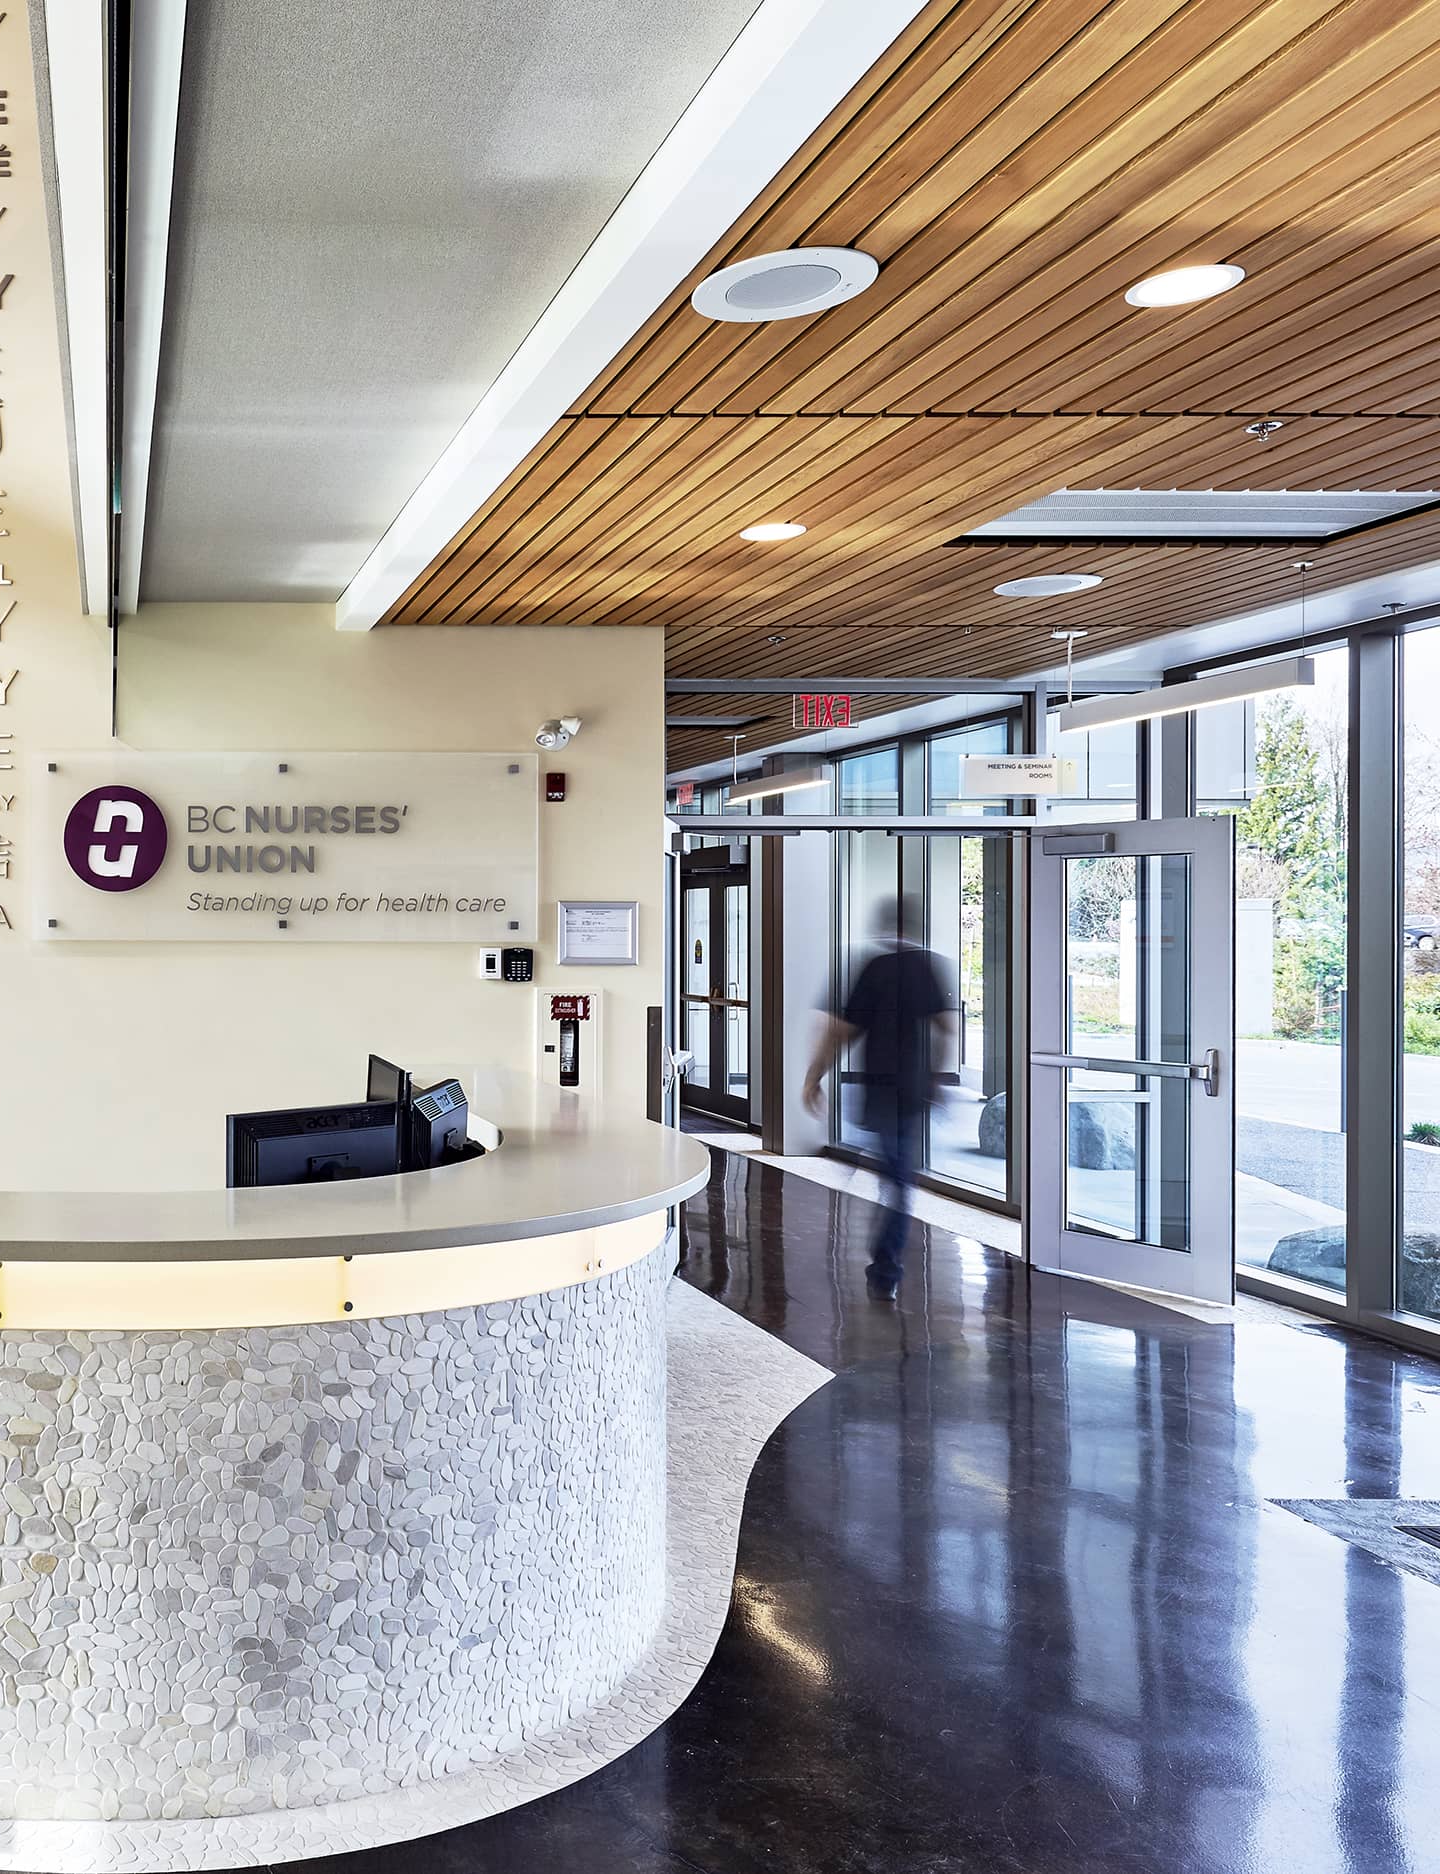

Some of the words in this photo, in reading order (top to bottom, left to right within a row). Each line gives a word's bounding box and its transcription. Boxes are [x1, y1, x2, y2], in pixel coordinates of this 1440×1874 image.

[186, 805, 237, 834] BC
[244, 805, 409, 835] NURSES'
[186, 845, 317, 874] UNION
[186, 892, 293, 915] Standing
[298, 899, 329, 915] up
[334, 892, 371, 912] for
[375, 892, 449, 912] health
[455, 897, 507, 912] care
